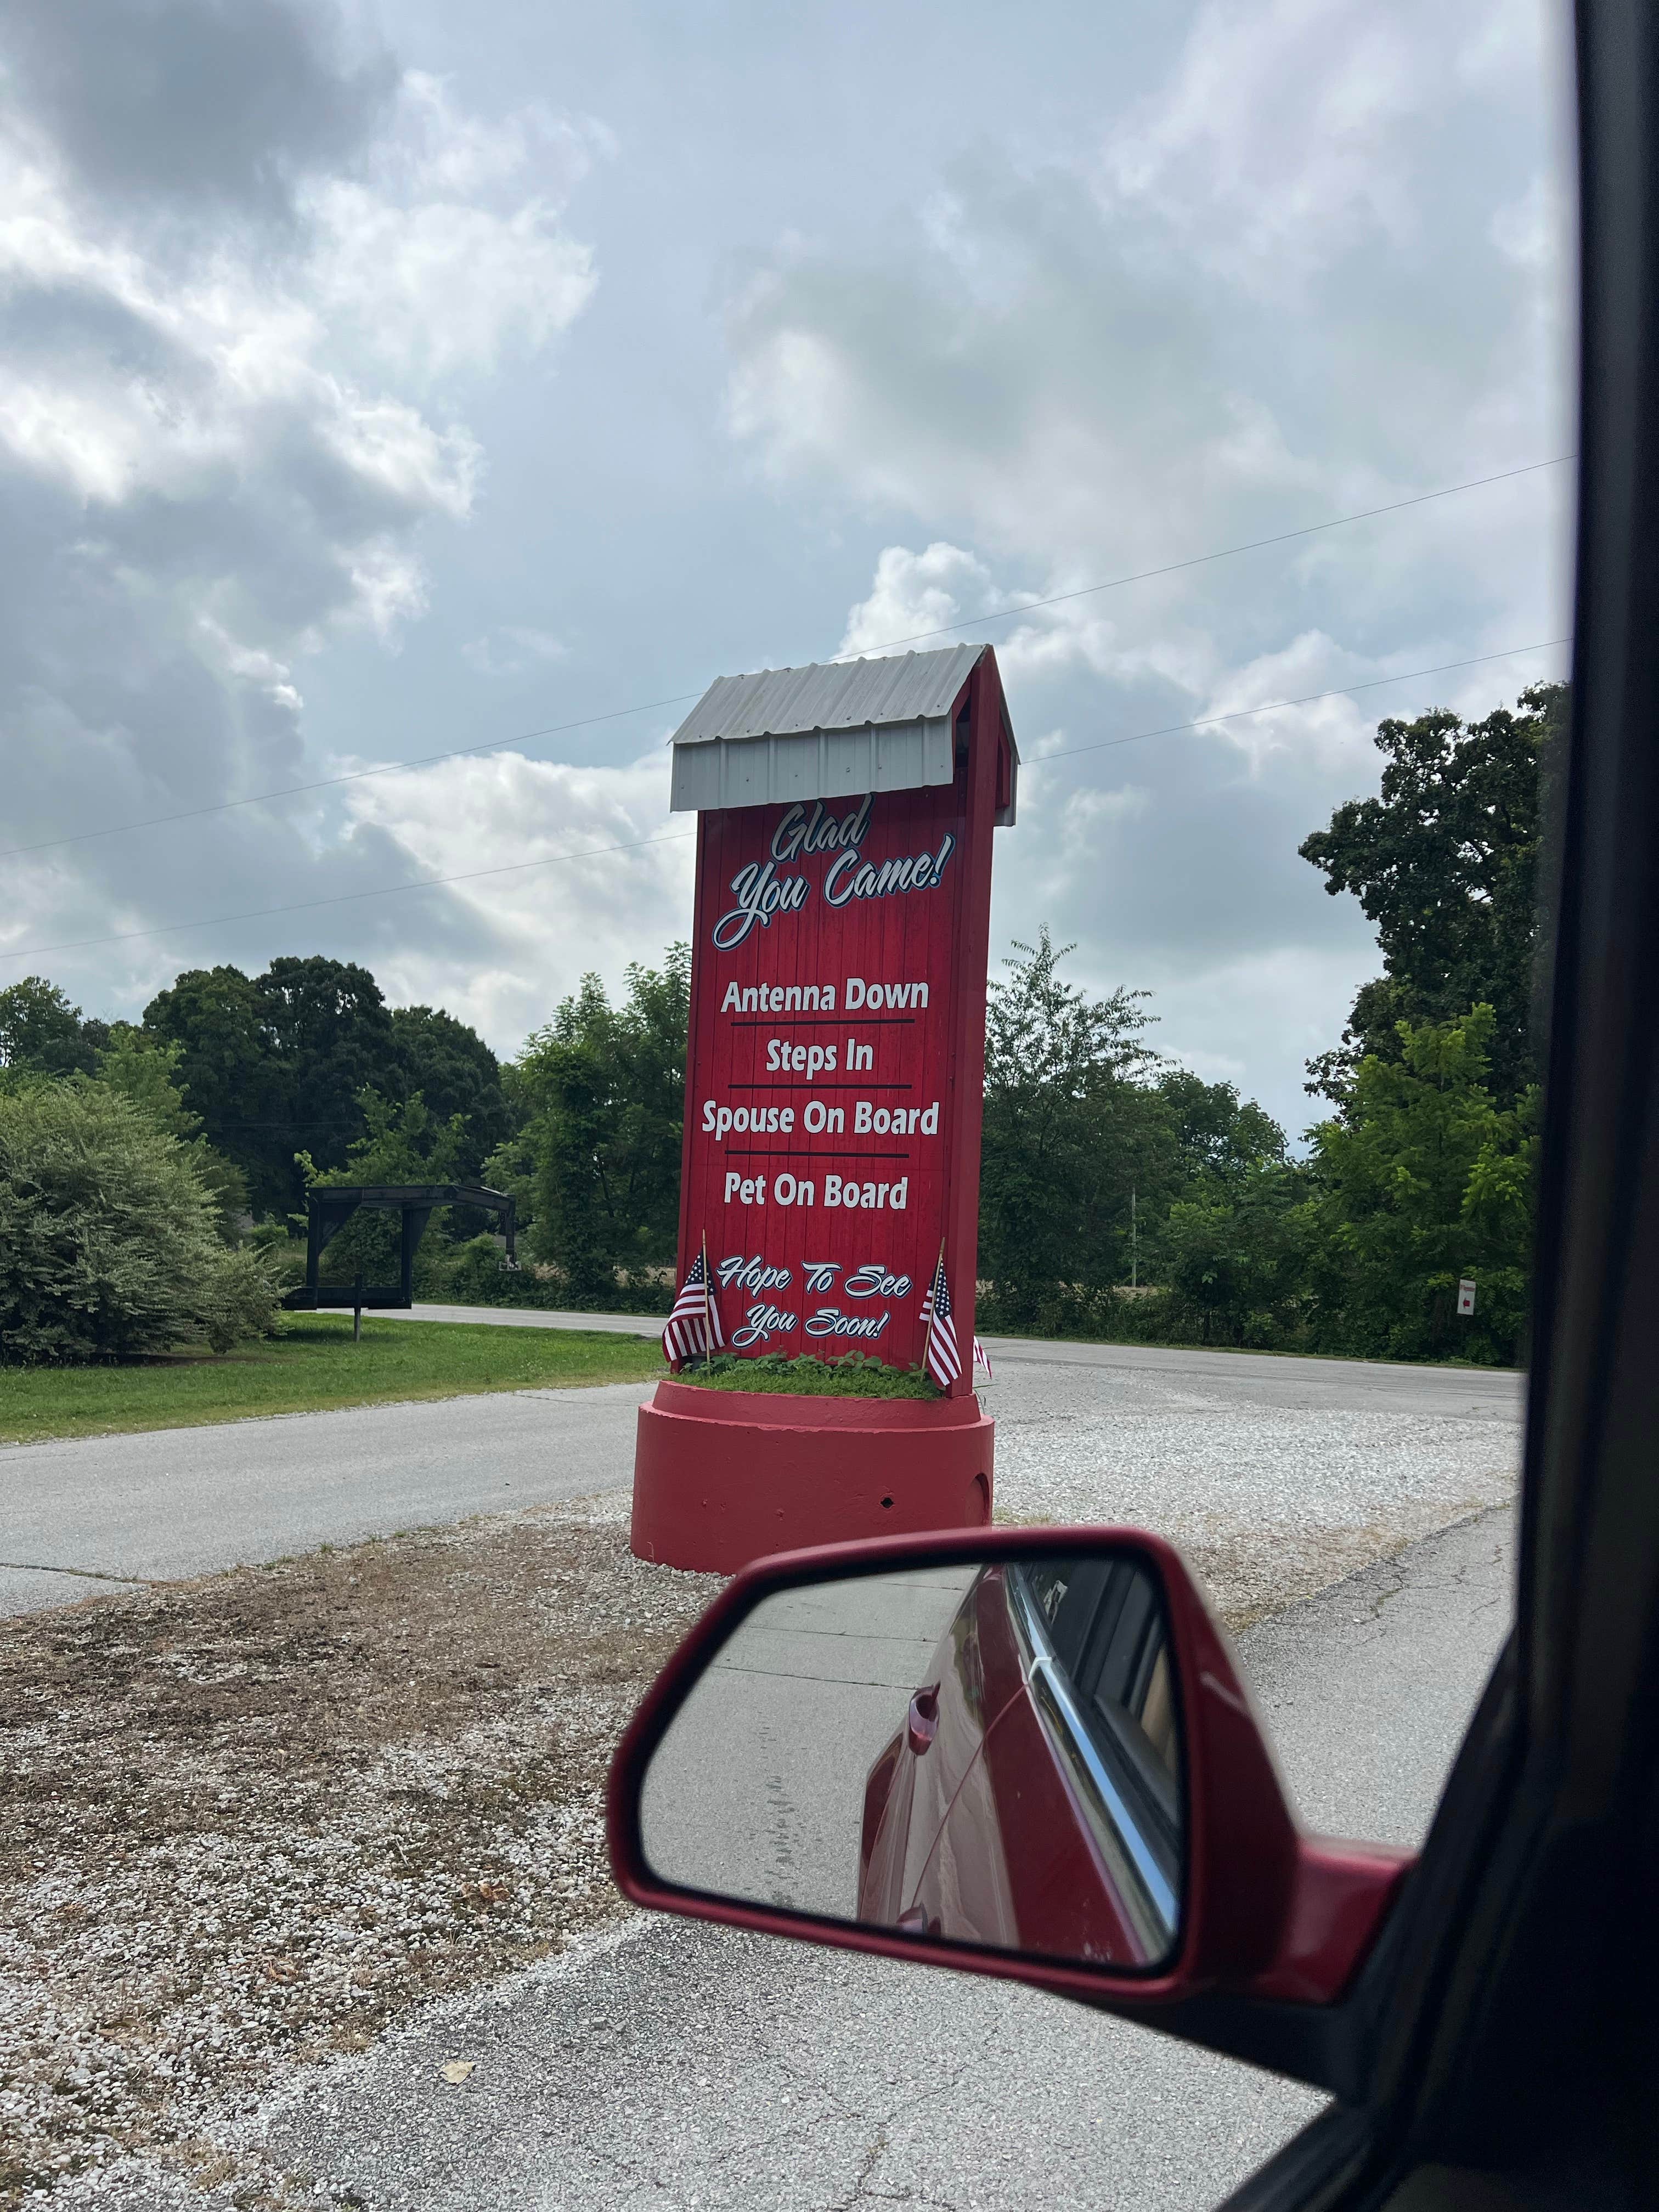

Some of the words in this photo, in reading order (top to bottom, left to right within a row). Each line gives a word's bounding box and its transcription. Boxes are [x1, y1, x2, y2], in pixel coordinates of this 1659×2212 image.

[771, 793, 873, 861] Glad
[713, 860, 809, 950] You
[824, 833, 955, 907] Came!
[720, 981, 836, 1012] Antenna
[845, 978, 929, 1010] Down
[766, 1039, 836, 1080] Steps
[846, 1039, 873, 1070] In
[702, 1100, 794, 1141] Spouse
[804, 1101, 844, 1133] On
[854, 1102, 939, 1135] Board
[724, 1172, 766, 1205] Pet
[774, 1172, 815, 1206] On
[824, 1175, 908, 1209] Board
[716, 1255, 791, 1297] Hope
[802, 1261, 842, 1293] To
[844, 1265, 912, 1298] See
[732, 1303, 798, 1348] You
[805, 1307, 889, 1339] Soon!
